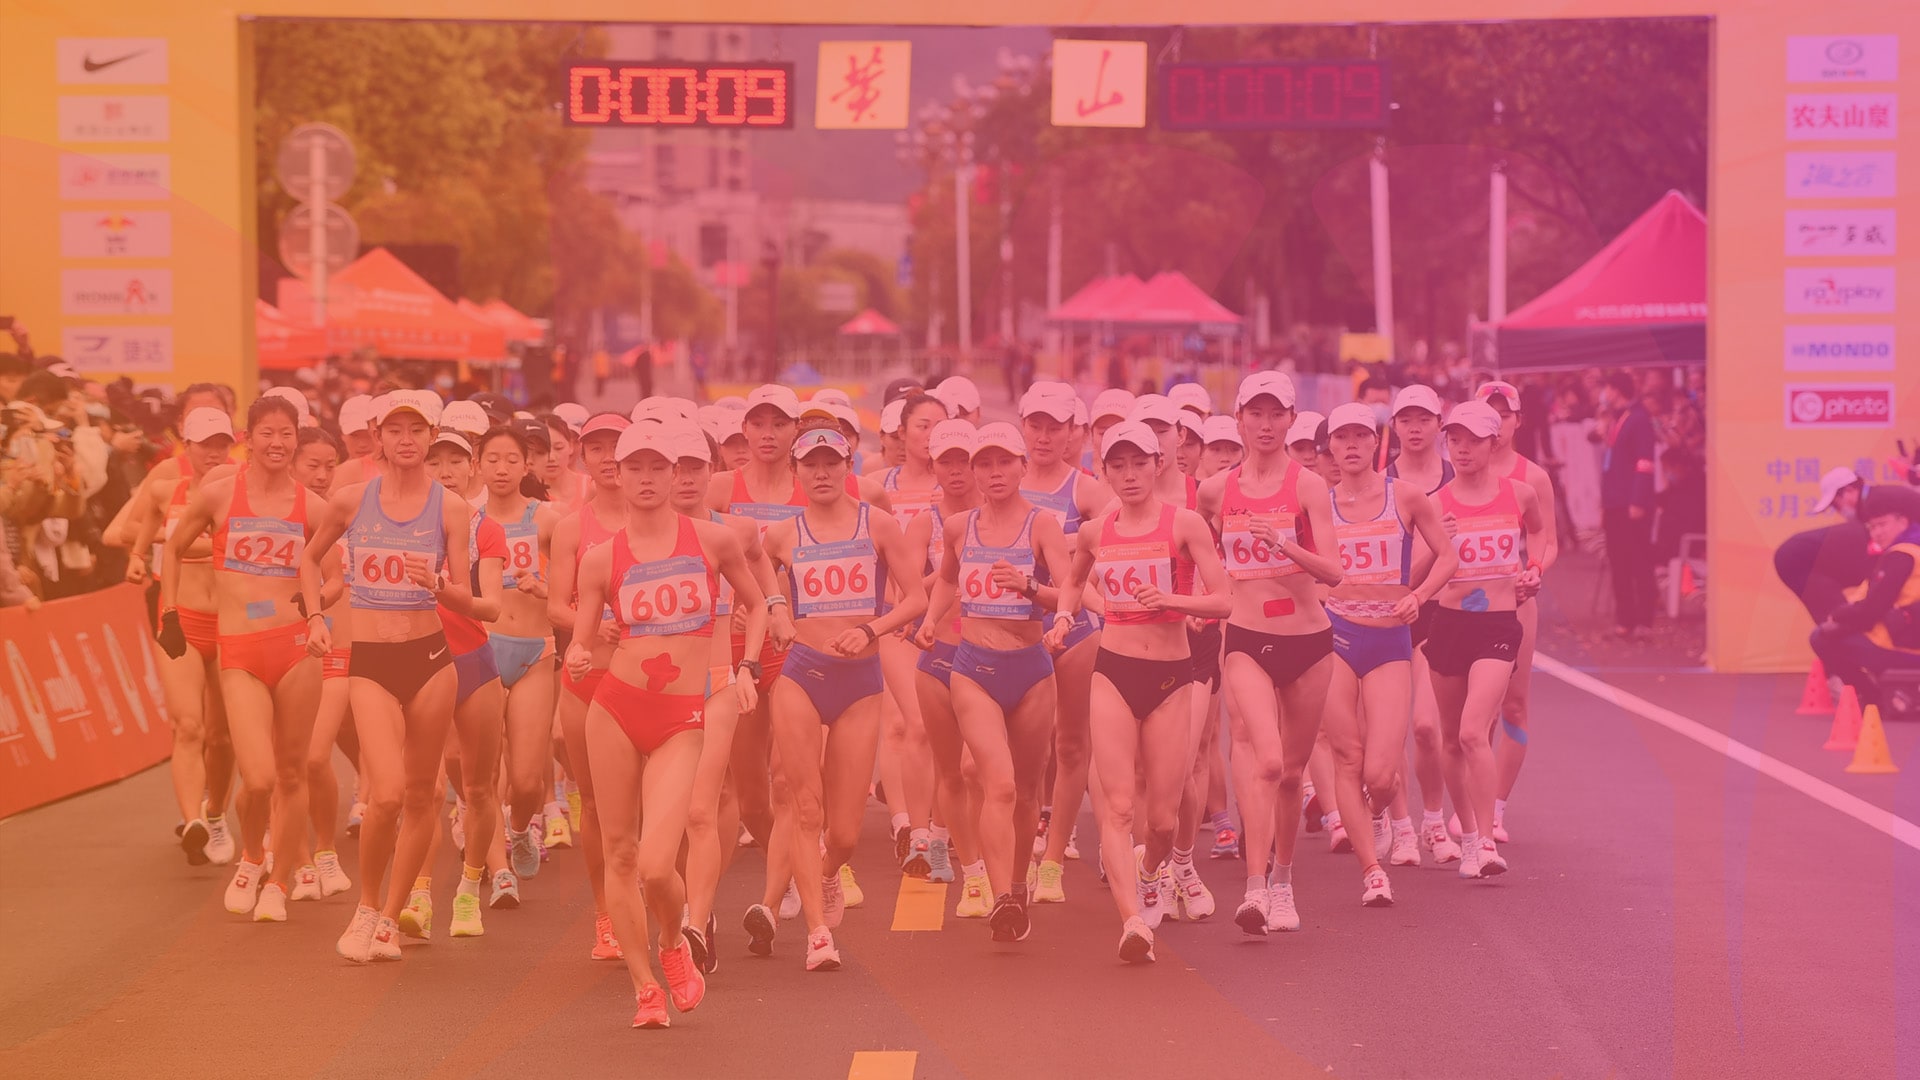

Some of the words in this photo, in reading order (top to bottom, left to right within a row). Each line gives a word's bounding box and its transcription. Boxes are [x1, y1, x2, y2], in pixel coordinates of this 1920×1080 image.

[570, 67, 785, 124] 0:00:09
[1077, 49, 1124, 117] 山
[1168, 65, 1380, 123] 0:00:09
[1808, 342, 1890, 357] MONDO
[389, 398, 421, 407] CHINA
[1825, 396, 1888, 419] photo
[940, 431, 970, 440] CHINA
[977, 432, 1008, 444] CHINA
[1766, 458, 1820, 483] 中国
[234, 536, 295, 566] 624
[1339, 540, 1388, 570] 651
[1459, 534, 1514, 563] 659
[363, 554, 416, 585] 60
[803, 563, 868, 597] 606
[1104, 565, 1157, 598] 661
[631, 580, 702, 621] 603
